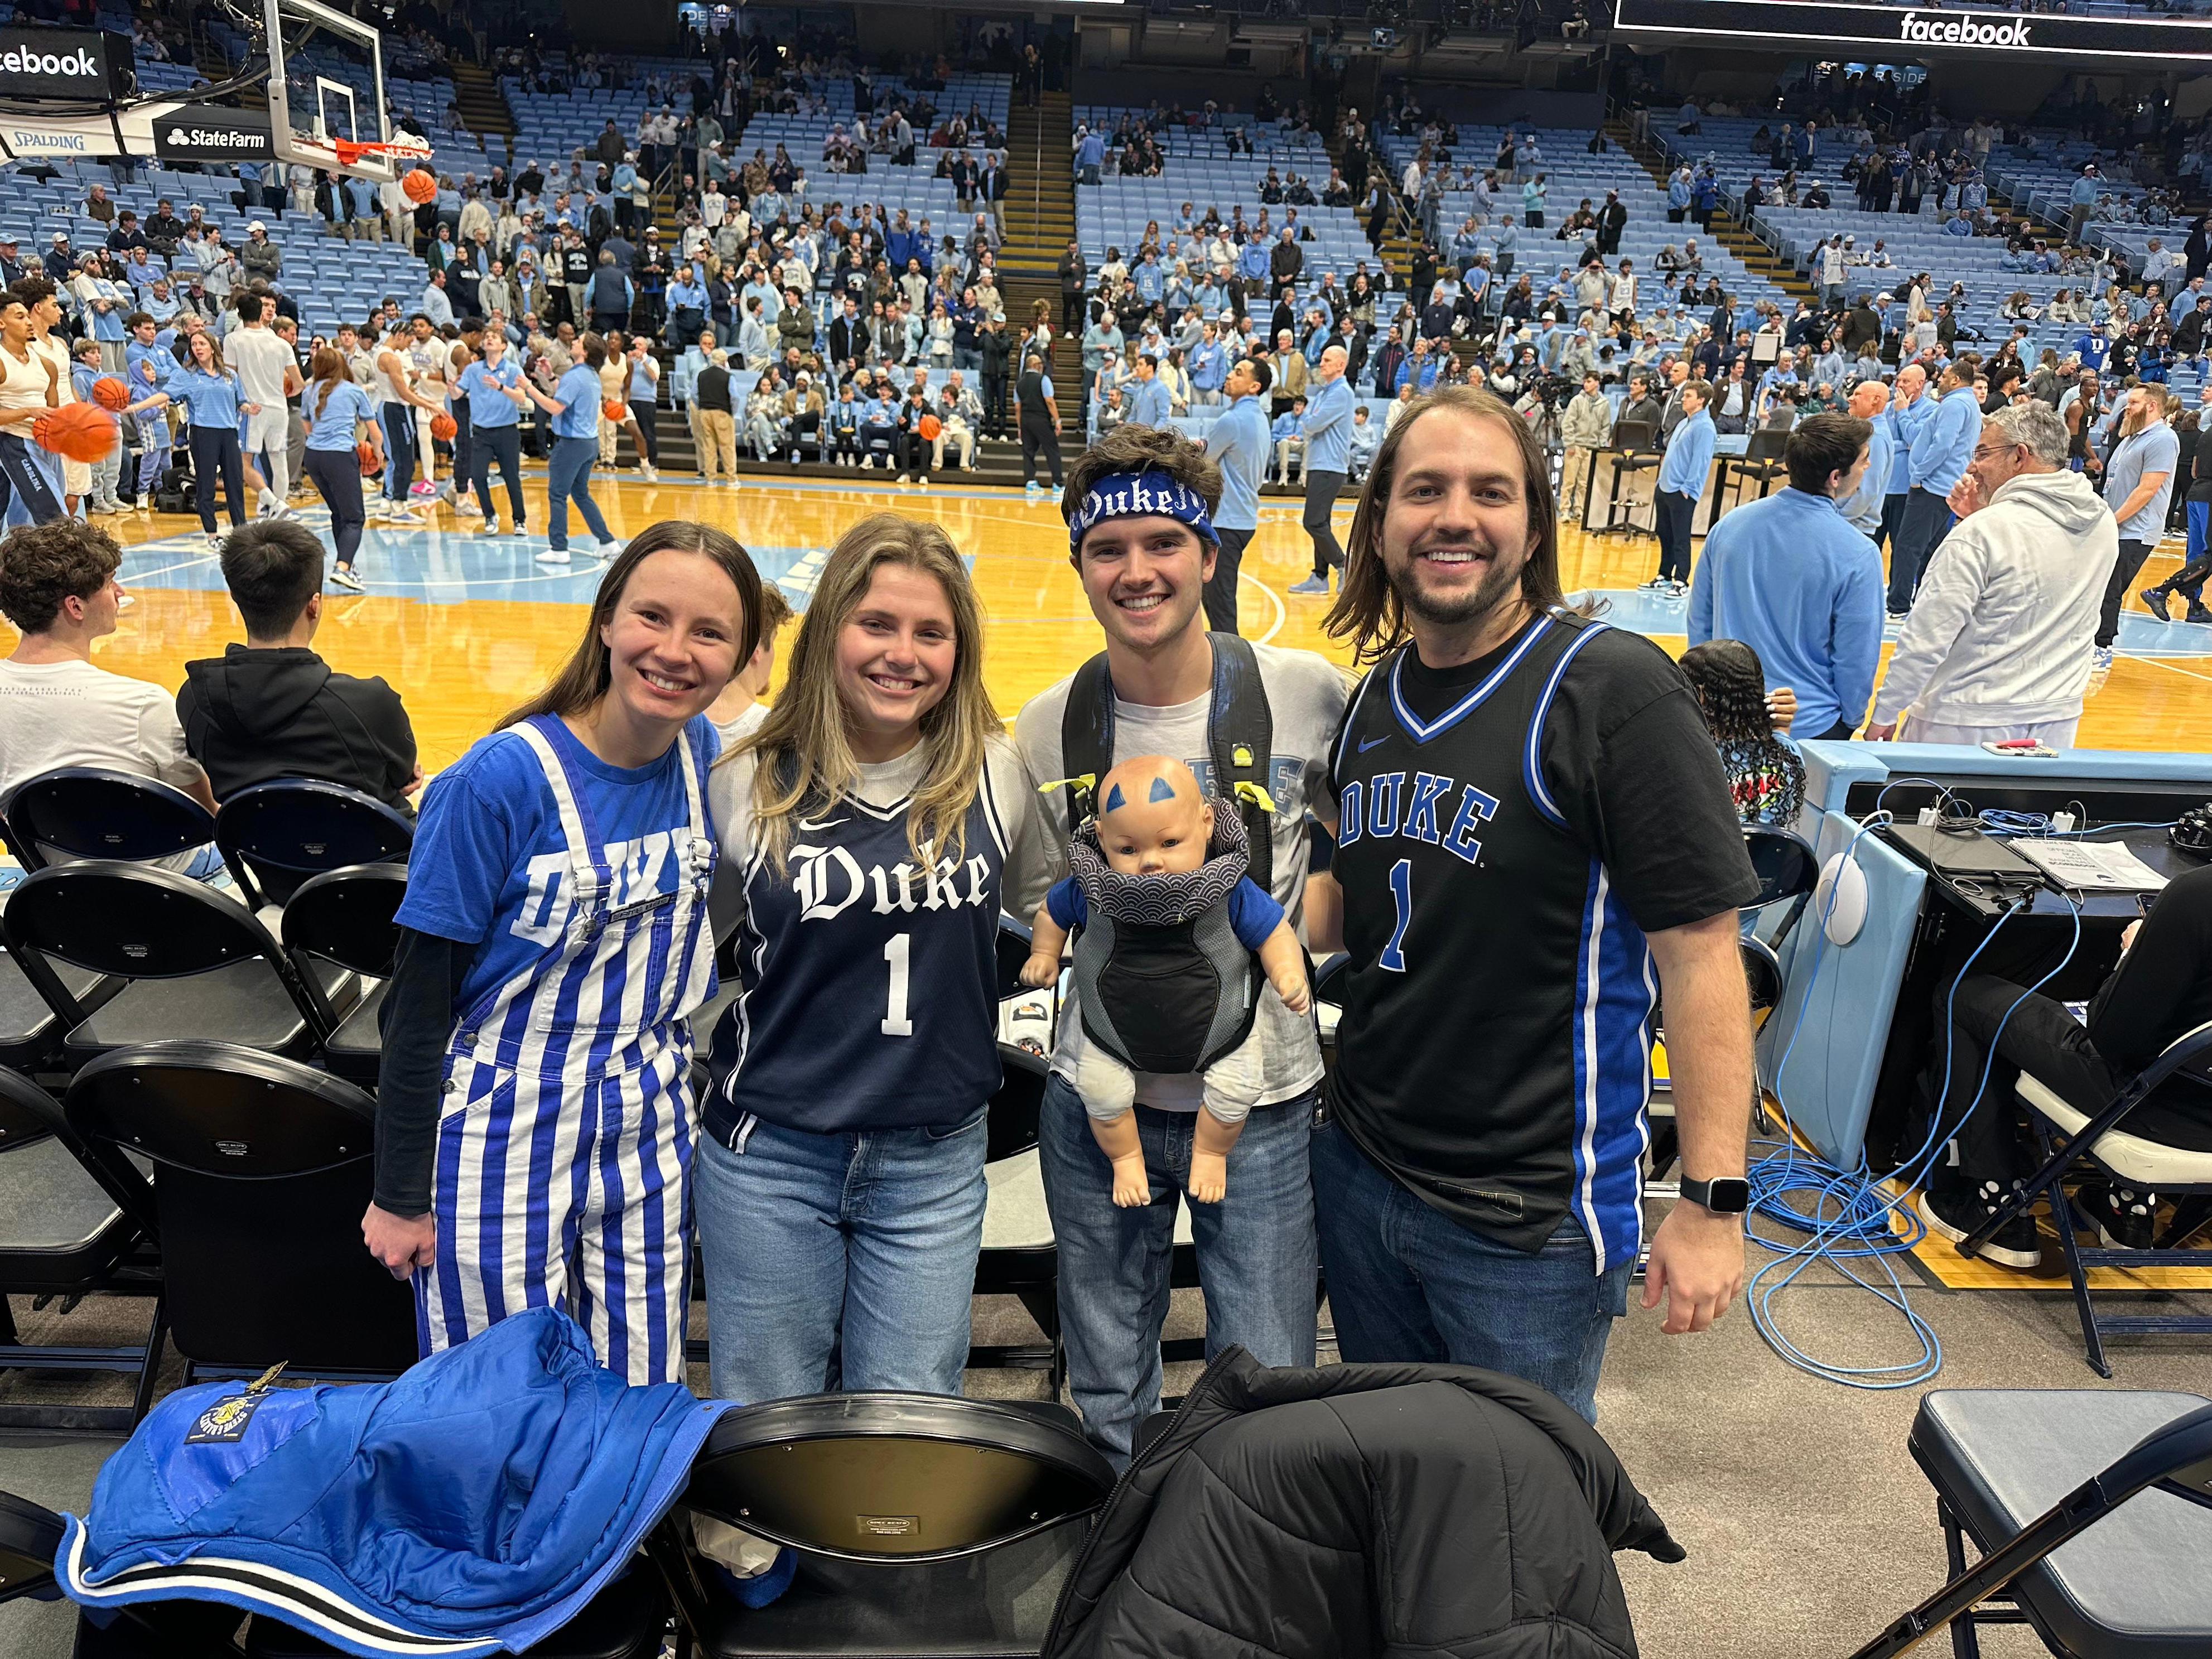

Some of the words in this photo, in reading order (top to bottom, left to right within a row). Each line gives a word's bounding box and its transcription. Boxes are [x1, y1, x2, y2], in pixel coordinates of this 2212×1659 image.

[1901, 12, 2031, 46] facebook
[15, 132, 85, 151] SPALDING
[21, 458, 43, 492] CAROLINA
[1339, 771, 1501, 865] DUKE
[788, 838, 990, 922] Duke
[1379, 859, 1411, 972] 1
[881, 933, 912, 1036] 1
